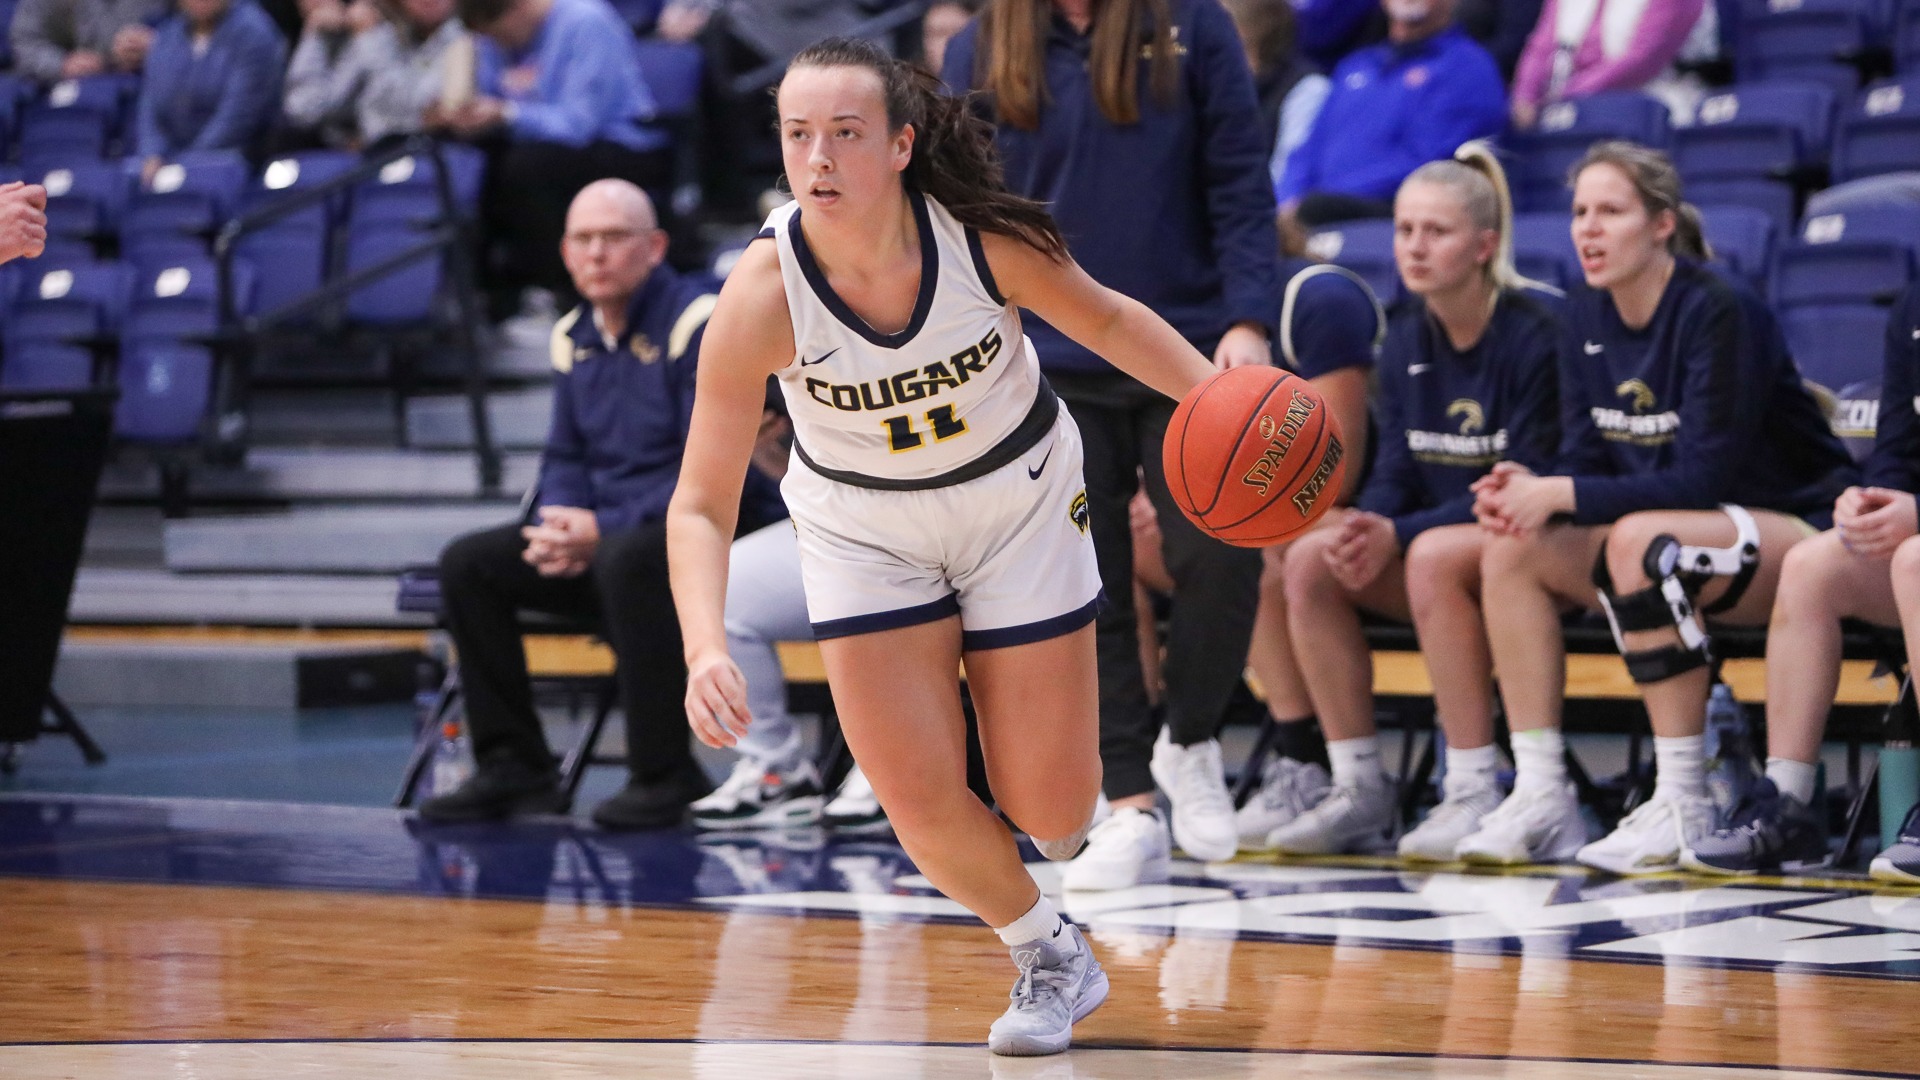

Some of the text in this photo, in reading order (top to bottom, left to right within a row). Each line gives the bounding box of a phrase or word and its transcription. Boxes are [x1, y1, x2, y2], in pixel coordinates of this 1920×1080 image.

[805, 327, 1003, 412] COUGARS
[880, 402, 969, 455] 11
[1242, 387, 1318, 496] SPALDING
[1291, 431, 1344, 519] NAIA
